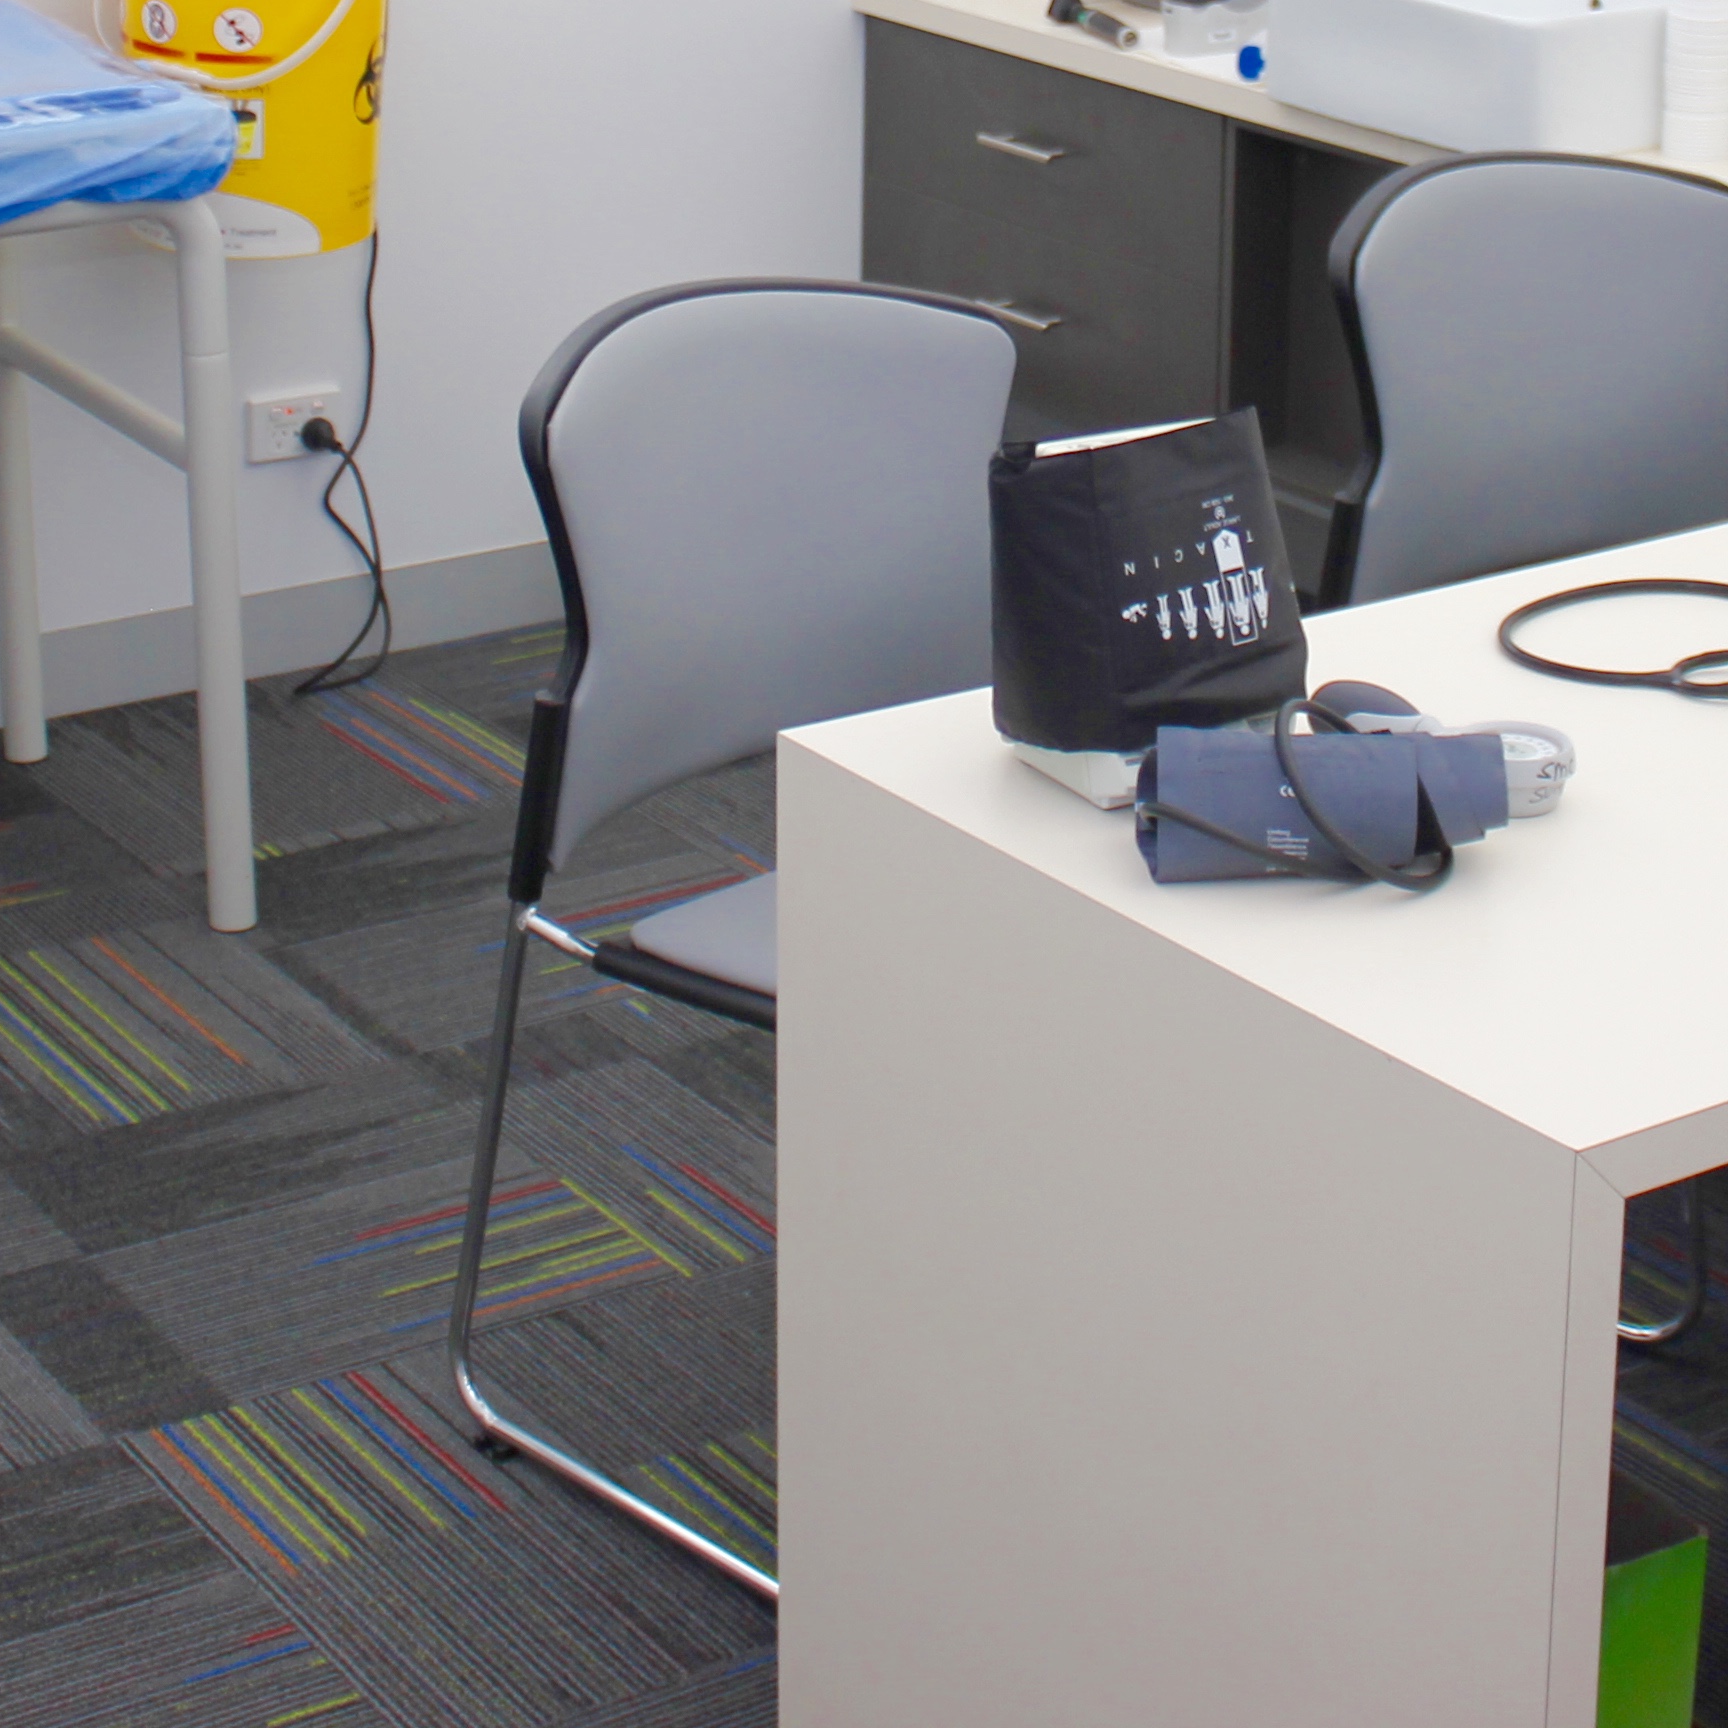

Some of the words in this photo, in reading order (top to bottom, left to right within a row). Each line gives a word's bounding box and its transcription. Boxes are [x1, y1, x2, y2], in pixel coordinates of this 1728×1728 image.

[1174, 549, 1184, 563] C
[1195, 542, 1206, 556] A
[1124, 562, 1136, 576] N
